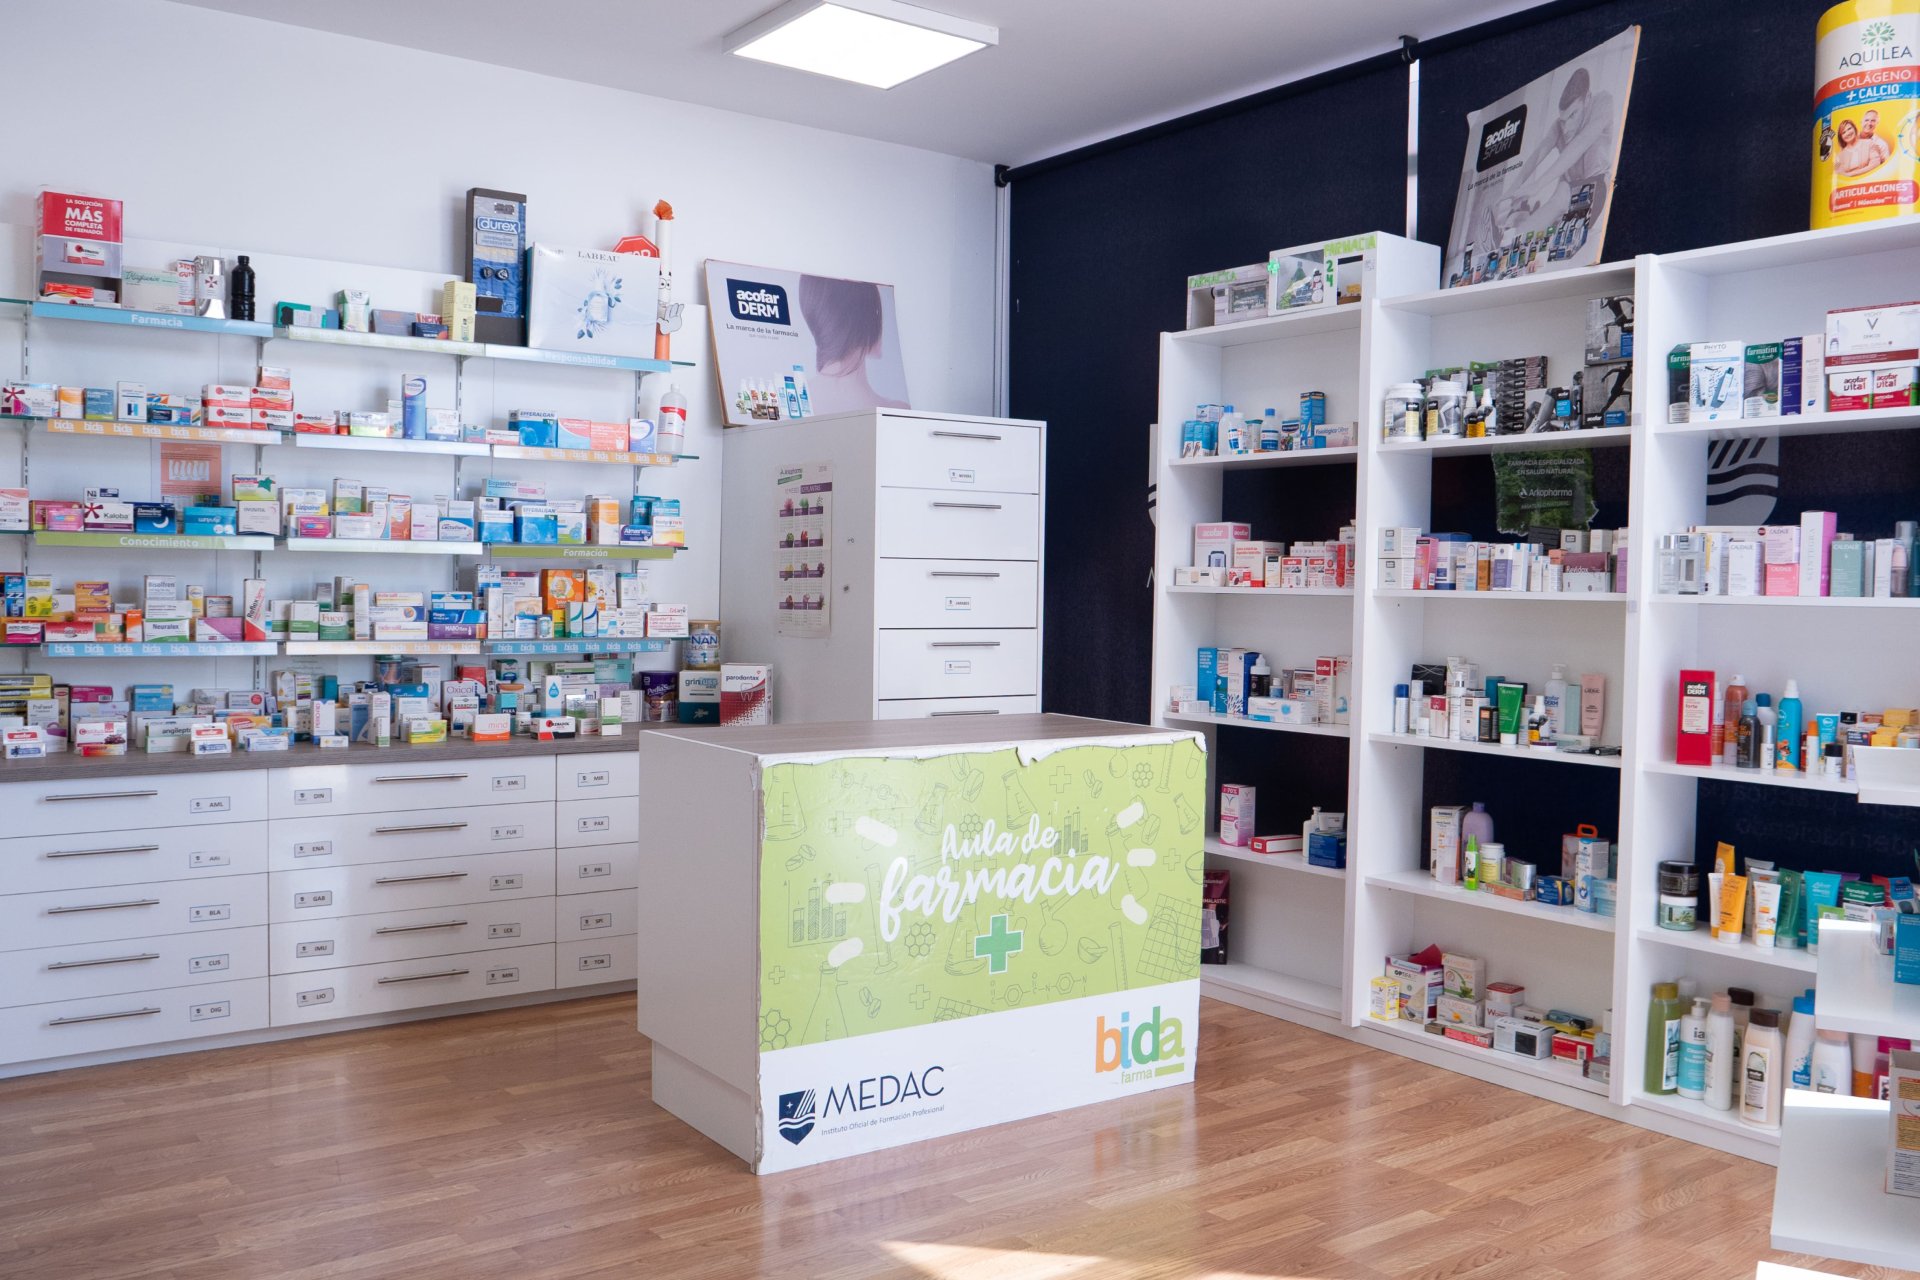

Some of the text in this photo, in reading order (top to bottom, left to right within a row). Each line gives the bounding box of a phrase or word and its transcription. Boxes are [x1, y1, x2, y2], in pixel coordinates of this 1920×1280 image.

[1839, 46, 1913, 69] AQUILEA
[1839, 69, 1912, 90] COLÁGENO
[1858, 83, 1900, 99] CALCIO
[1485, 119, 1521, 149] acofar
[1483, 136, 1516, 161] SPORT
[1502, 161, 1523, 176] farmacia
[1833, 182, 1908, 200] ARTICULACIONES
[74, 199, 103, 207] SOLUCIÓN
[65, 206, 103, 223] MÁS
[65, 220, 103, 230] COMPLETA
[480, 220, 518, 232] durex
[736, 289, 779, 304] acofar
[738, 301, 780, 318] DERM
[131, 314, 183, 328] Farmacia
[726, 323, 735, 331] La
[736, 325, 755, 333] marca
[772, 328, 799, 337] farmacia
[1670, 354, 1690, 363] farma
[1844, 375, 1867, 384] acofar
[1876, 373, 1898, 381] acofar
[1876, 380, 1896, 388] vital
[1843, 382, 1866, 391] vital
[1529, 488, 1573, 497] Arkopharma
[121, 537, 199, 548] Conocimiento
[564, 549, 608, 558] Formación
[691, 636, 718, 645] NAN
[446, 686, 474, 694] Oxicol
[162, 727, 191, 736] angilepto
[488, 721, 508, 729] mind
[942, 813, 1058, 864] Aula de
[879, 850, 1119, 942] farmacia
[1095, 1006, 1186, 1074] bida
[1121, 1068, 1153, 1085] farma
[823, 1066, 944, 1118] MEDAC
[821, 1126, 848, 1136] Instituto
[849, 1120, 869, 1130] Oficial
[879, 1111, 911, 1123] Formación
[912, 1105, 945, 1117] Profesional
